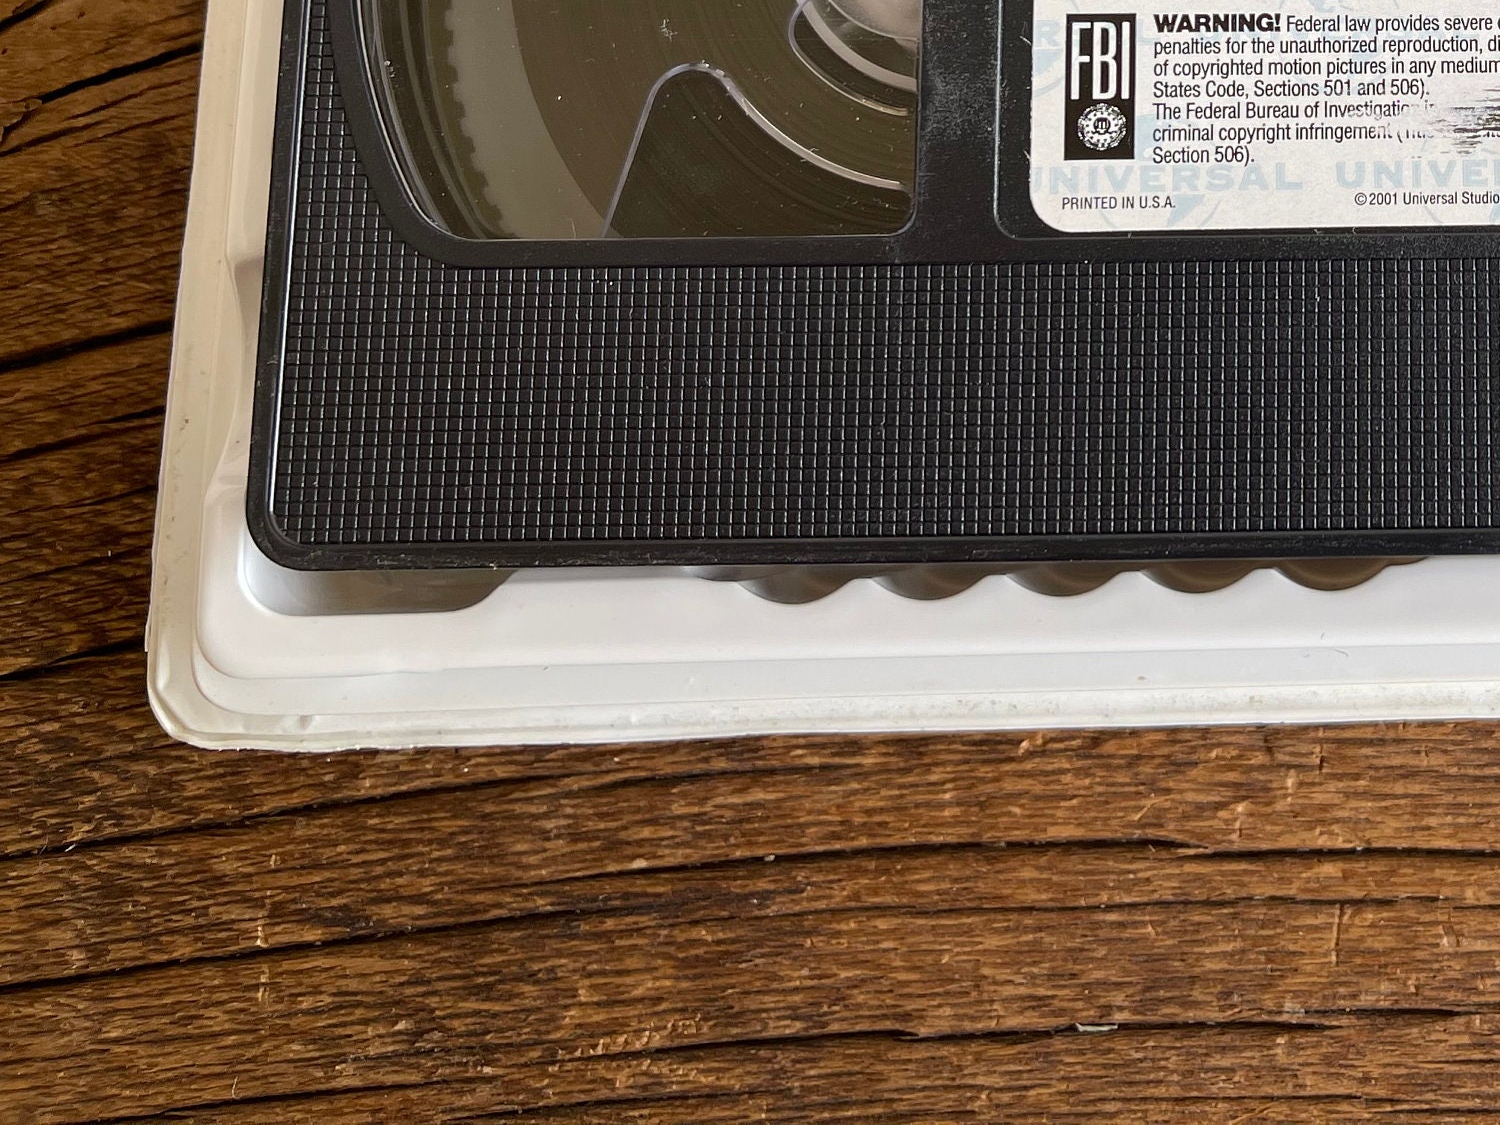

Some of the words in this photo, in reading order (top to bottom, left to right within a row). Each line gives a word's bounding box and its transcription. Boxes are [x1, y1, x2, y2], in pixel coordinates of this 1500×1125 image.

[1153, 13, 1281, 33] WARNING!
[1286, 15, 1341, 32] Federal
[1344, 15, 1371, 32] law
[1375, 14, 1439, 35] provides
[1444, 17, 1493, 31] severe
[1153, 37, 1221, 58] penalties
[1226, 37, 1247, 55] for
[1251, 37, 1275, 54] the
[1280, 36, 1377, 54] unauthorized
[1382, 36, 1482, 56] reproduction,
[1069, 21, 1131, 101] FBI
[1153, 59, 1170, 76] of
[1173, 58, 1263, 80] copyrighted
[1268, 59, 1321, 76] motion
[1326, 58, 1387, 80] pictures
[1391, 58, 1405, 75] in
[1409, 61, 1437, 79] any
[1153, 80, 1201, 98] States
[1205, 81, 1249, 100] Code,
[1253, 79, 1320, 98] Sections
[1323, 79, 1352, 97] 501
[1357, 79, 1386, 96] and
[1390, 78, 1430, 99] 506).
[1153, 102, 1181, 120] The
[1185, 101, 1241, 120] Federal
[1246, 102, 1300, 119] Bureau
[1304, 101, 1321, 118] of
[1152, 124, 1214, 143] criminal
[1218, 123, 1291, 148] copyright
[1152, 147, 1210, 164] Section
[1214, 145, 1255, 167] 506).
[1061, 196, 1118, 210] PRINTED
[1121, 195, 1135, 209] IN
[1139, 195, 1177, 209] U.S.A.
[1354, 191, 1398, 206] ©2001
[1403, 191, 1458, 205] Universal
